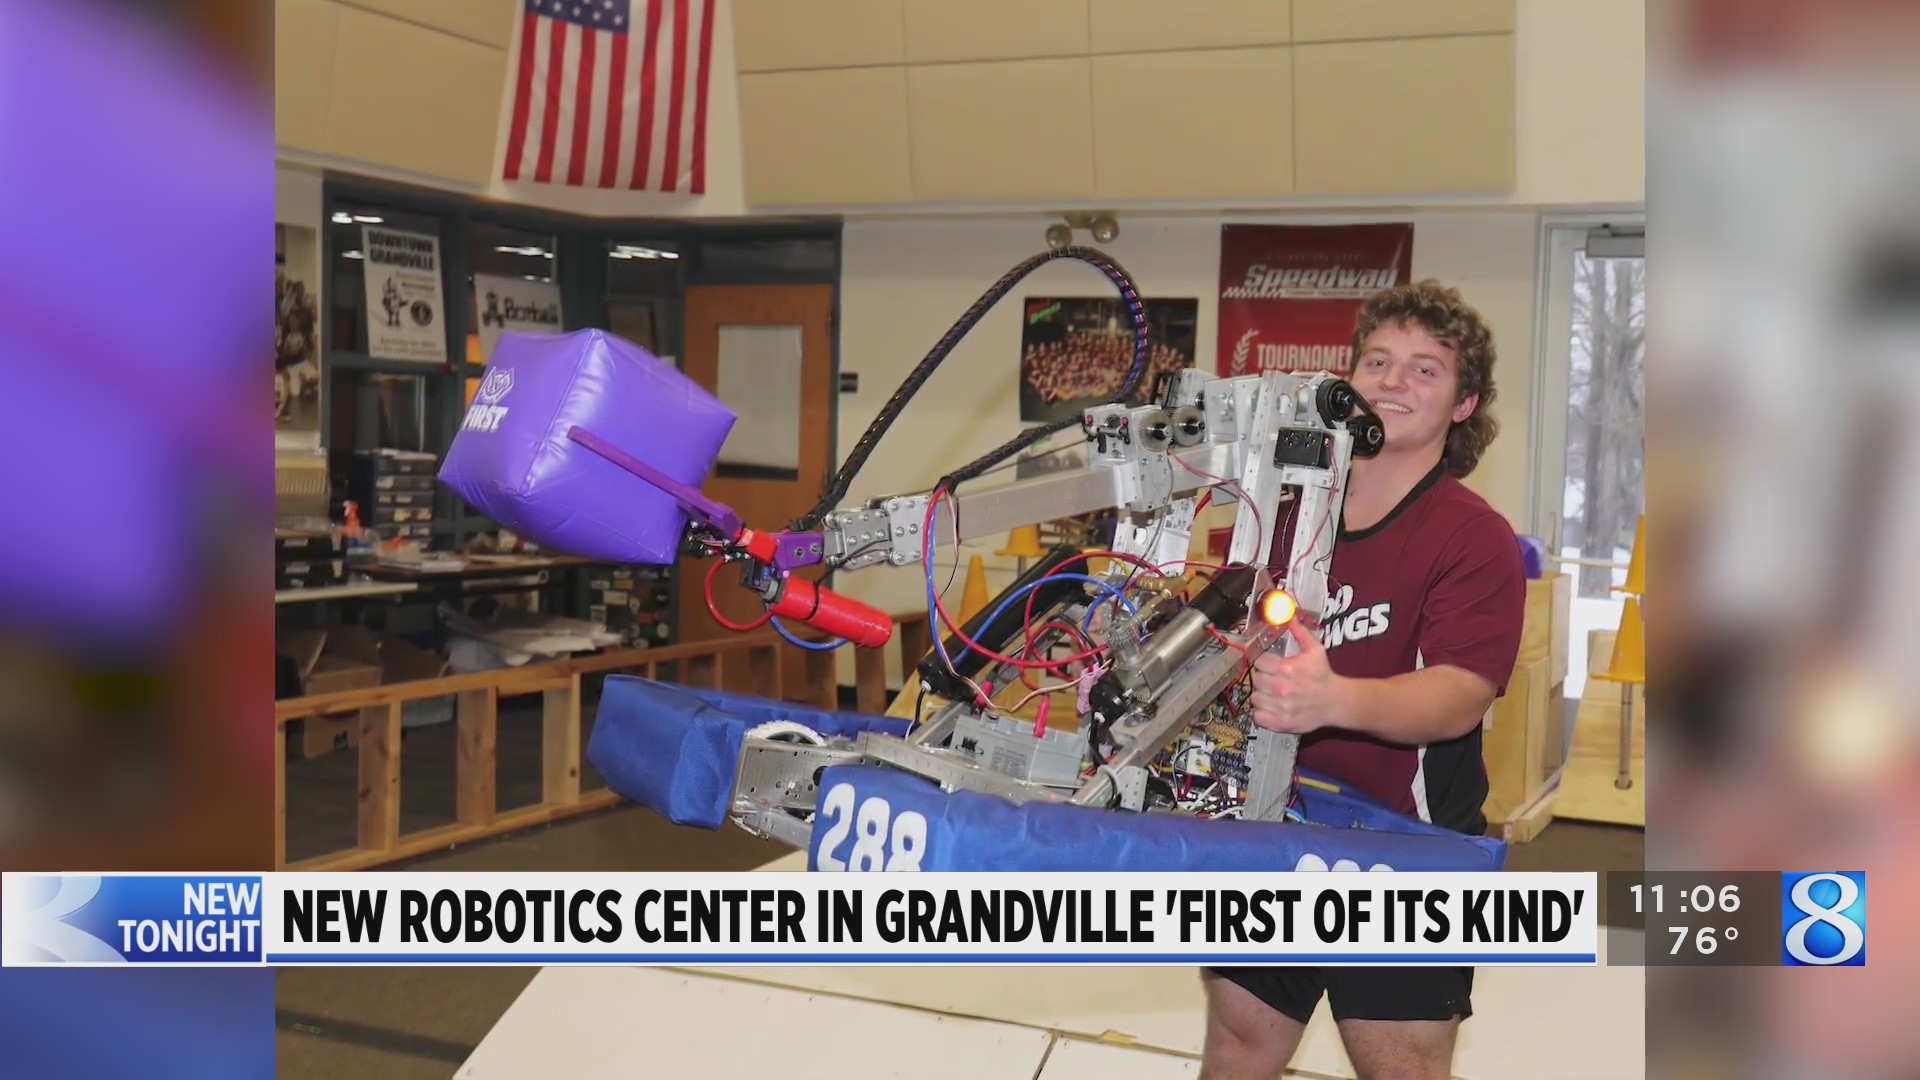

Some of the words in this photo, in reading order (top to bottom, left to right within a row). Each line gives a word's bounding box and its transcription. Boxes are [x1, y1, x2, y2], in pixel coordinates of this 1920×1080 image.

[1245, 264, 1398, 298] Speedway
[463, 404, 509, 433] FIRST
[817, 783, 927, 872] 288
